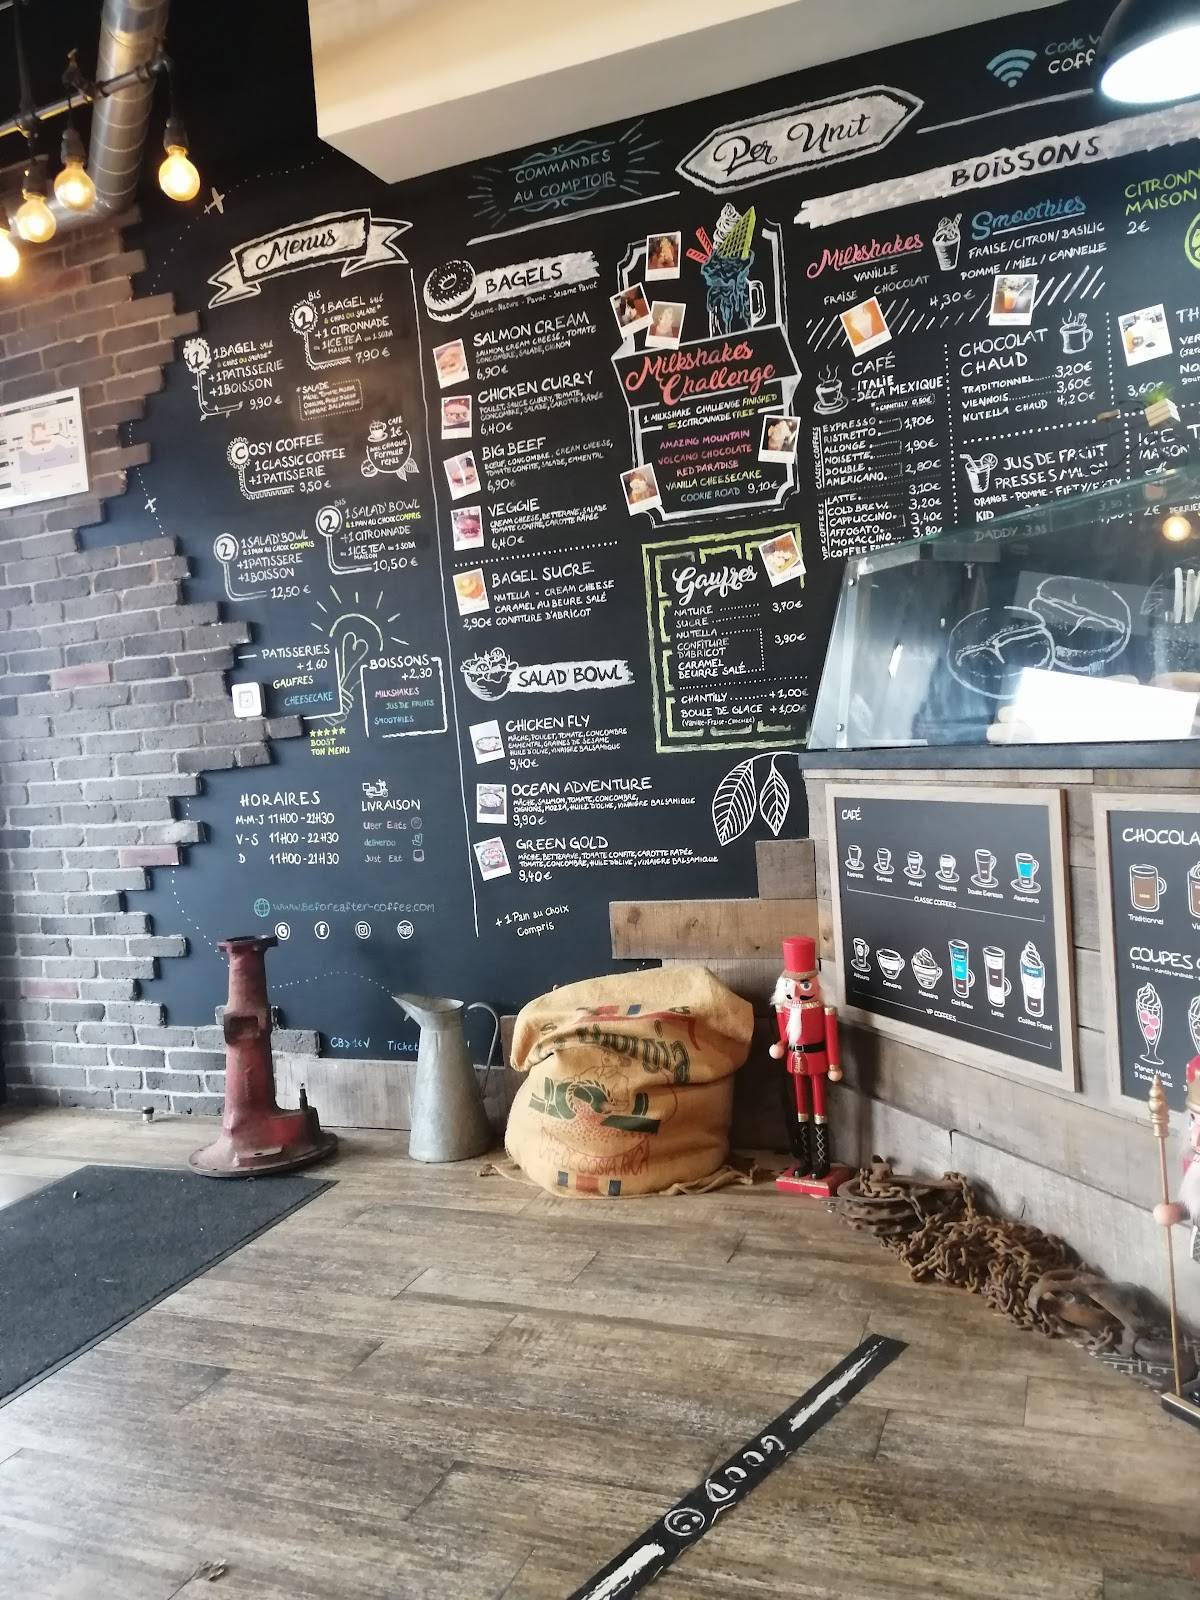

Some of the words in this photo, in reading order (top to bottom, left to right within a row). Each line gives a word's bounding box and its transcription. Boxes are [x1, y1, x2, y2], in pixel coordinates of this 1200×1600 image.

[713, 135, 778, 177] Per
[787, 113, 871, 154] Unit
[515, 149, 611, 184] COMMANDES
[513, 188, 534, 204] AU
[540, 171, 616, 198] COMPTOIR
[1125, 188, 1197, 216] MAISON
[971, 195, 1087, 240] Smoothies
[1126, 220, 1150, 235] 2€
[255, 228, 337, 270] Menus
[806, 233, 925, 279] Milkshakes
[960, 265, 1001, 281] POMME
[1049, 241, 1107, 263] CANNELLE
[485, 262, 563, 294] BAGELS
[873, 274, 931, 295] CHOCOLAT
[307, 289, 321, 301] BIS
[473, 323, 532, 347] SALMON
[534, 311, 590, 334] CREAM
[343, 333, 363, 346] TEA
[958, 328, 1049, 358] CHOCOLAT
[625, 340, 753, 391] Milkshakes
[851, 350, 896, 377] CAFÉ
[960, 351, 1028, 378] CHAUD
[477, 380, 538, 404] CHICKEN
[541, 370, 594, 392] CURRY
[662, 363, 776, 406] Challenge
[889, 376, 944, 396] MEXIQUE
[961, 374, 1034, 394] TRADITIONNEL
[961, 392, 1009, 409] VIENNOIS
[1056, 377, 1092, 394] 3,60€
[650, 407, 691, 422] MILKSHAKE
[695, 399, 741, 415] CHALLENGE
[742, 393, 778, 407] FINISHED
[732, 408, 755, 420] FREE
[962, 405, 1010, 423] NUTELLA
[1015, 399, 1048, 412] CHAUD
[822, 416, 877, 433] EXPRESSO
[276, 433, 324, 452] COFFEE
[659, 435, 700, 450] AMAZING
[702, 429, 750, 445] MOUNTAIN
[823, 428, 877, 444] RISTRETTO
[305, 447, 346, 464] COFFEE
[481, 444, 505, 460] BIG
[507, 436, 547, 456] BEEF
[657, 452, 699, 465] VOLCANO
[701, 444, 753, 460] CHOCOLATE
[823, 440, 866, 454] ALLONGE
[824, 451, 872, 464] NOISETTE
[1003, 455, 1034, 471] JUS
[1034, 452, 1056, 466] DE
[676, 465, 695, 477] RED
[697, 460, 739, 474] PARADISE
[825, 463, 866, 476] DOUBLE
[665, 478, 698, 491] VANILLA
[699, 469, 762, 487] CHEESECAKE
[680, 489, 712, 502] COOKIE
[714, 487, 741, 499] ROAD
[827, 493, 858, 505] LATTE
[973, 494, 1007, 506] ORANGE
[1015, 489, 1048, 500] POMME
[388, 498, 421, 512] BOWL
[487, 498, 541, 518] VEGGIE
[827, 505, 853, 517] COLD
[975, 509, 995, 522] KID
[829, 525, 881, 537] AFFOGATO
[491, 568, 539, 589] BAGEL
[542, 561, 595, 582] SUCRE
[493, 590, 531, 602] NUTELLA
[544, 584, 577, 597] CREAM
[578, 579, 615, 593] CHEESE
[672, 565, 758, 606] Gaufres
[494, 601, 537, 614] CARAMEL
[536, 599, 550, 609] AU
[551, 597, 583, 609] BEURE
[585, 592, 608, 603] SALÉ
[673, 605, 714, 618] NATURE
[675, 616, 709, 628] SUCRE
[676, 628, 718, 639] NUTELLA
[262, 643, 330, 660] PATISSERIES
[369, 653, 430, 670] BOISSONS
[678, 659, 724, 671] CARAMEL
[573, 664, 623, 683] BOWL
[678, 668, 719, 680] BEURRE
[273, 675, 314, 690] GAUFRES
[284, 691, 334, 707] CHEESECAKE
[374, 687, 420, 699] MILKSHAKES
[681, 706, 713, 718] BOULE
[715, 706, 729, 716] DE
[732, 704, 763, 715] GLACE
[374, 715, 414, 725] SMOOTHIES
[505, 717, 564, 734] CHICKEN
[566, 714, 591, 728] FLY
[310, 737, 337, 747] BOOST
[310, 747, 326, 756] TON
[327, 746, 350, 756] MENU
[511, 782, 561, 797] OCEAN
[563, 776, 653, 794] ADVENTURE
[239, 791, 321, 807] HORAIRES
[361, 799, 421, 812] LIVRAISON
[268, 812, 299, 825] 11H00
[841, 806, 862, 821] CAFÉ
[386, 820, 407, 830] Eats
[268, 832, 299, 844] 11H00
[307, 832, 339, 844] 22H30
[516, 838, 567, 852] GREEN
[569, 836, 609, 850] GOLD
[269, 852, 301, 865] 11H00
[307, 852, 340, 865] 21H30
[364, 854, 382, 863] Just
[388, 854, 403, 862] Eat
[1130, 946, 1193, 970] COUPES
